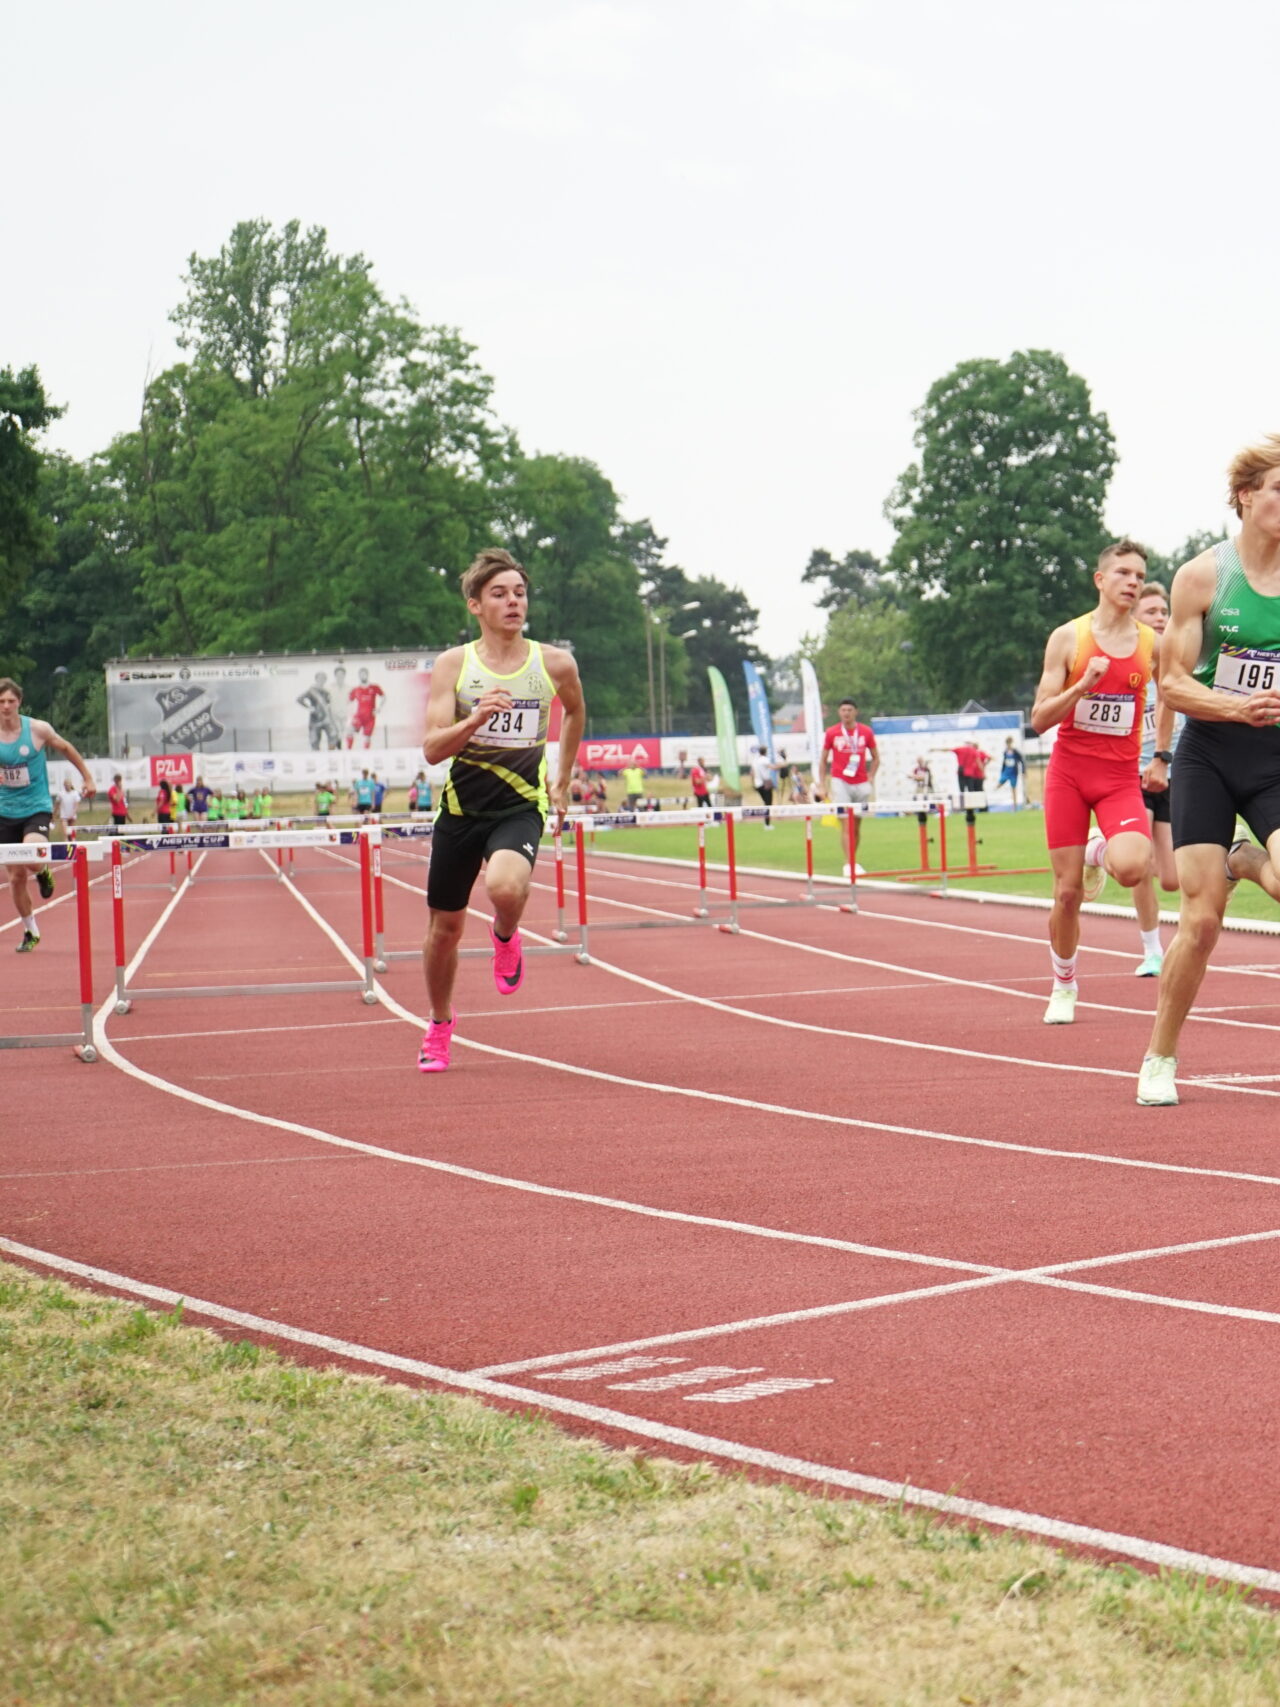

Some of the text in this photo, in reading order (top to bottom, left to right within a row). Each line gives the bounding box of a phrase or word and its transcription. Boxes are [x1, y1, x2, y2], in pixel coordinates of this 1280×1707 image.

[1237, 663, 1275, 690] 195
[488, 711, 523, 733] 234
[1089, 703, 1122, 723] 283
[586, 743, 649, 761] PZLA
[156, 758, 188, 777] PZLA
